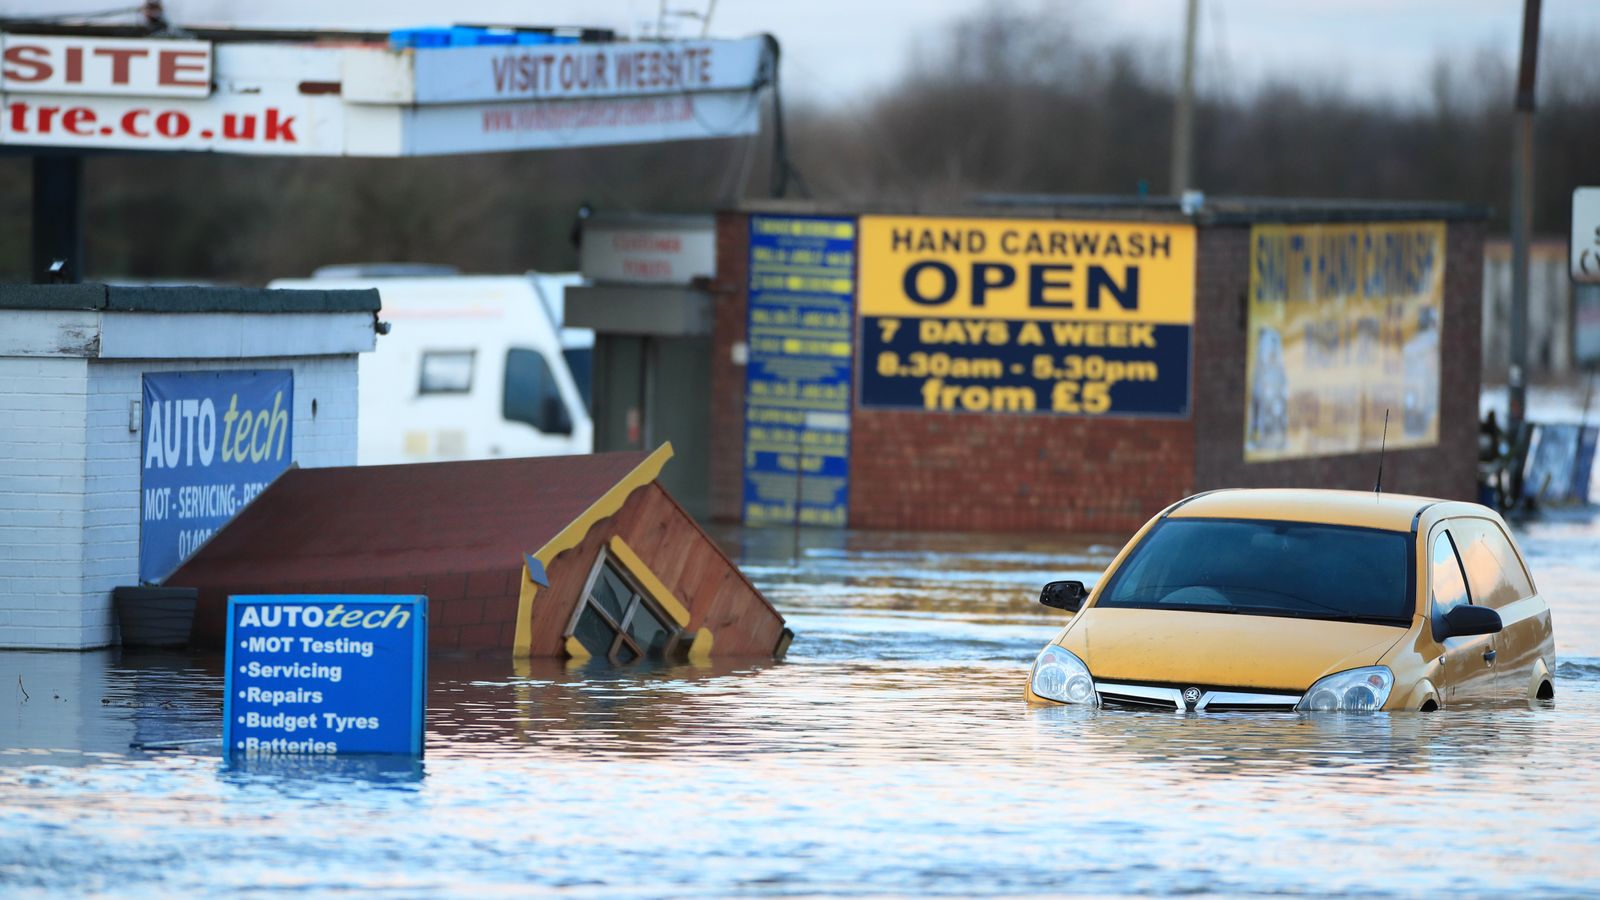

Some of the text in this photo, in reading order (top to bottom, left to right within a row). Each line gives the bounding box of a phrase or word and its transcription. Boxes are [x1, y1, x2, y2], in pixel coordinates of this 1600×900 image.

[3, 46, 208, 87] SITE
[491, 48, 712, 92] VISIT OUR WEBSITE
[891, 228, 1172, 259] HAND CARWASH
[903, 260, 1139, 311] OPEN
[879, 319, 899, 344] 7
[919, 320, 1010, 346] DAYS
[1017, 322, 1045, 346] A
[1051, 321, 1157, 348] WEEK
[877, 352, 1003, 378] 8.30am
[1032, 354, 1158, 384] 5.30pm
[921, 379, 1112, 414] from £5
[145, 487, 171, 520] MOT
[178, 484, 235, 519] SERVICING
[248, 637, 374, 657] MOT Testing
[247, 661, 342, 682] Servicing
[247, 687, 323, 706] Repairs
[246, 712, 380, 732] Budget Tyres
[245, 737, 337, 753] Batteries
